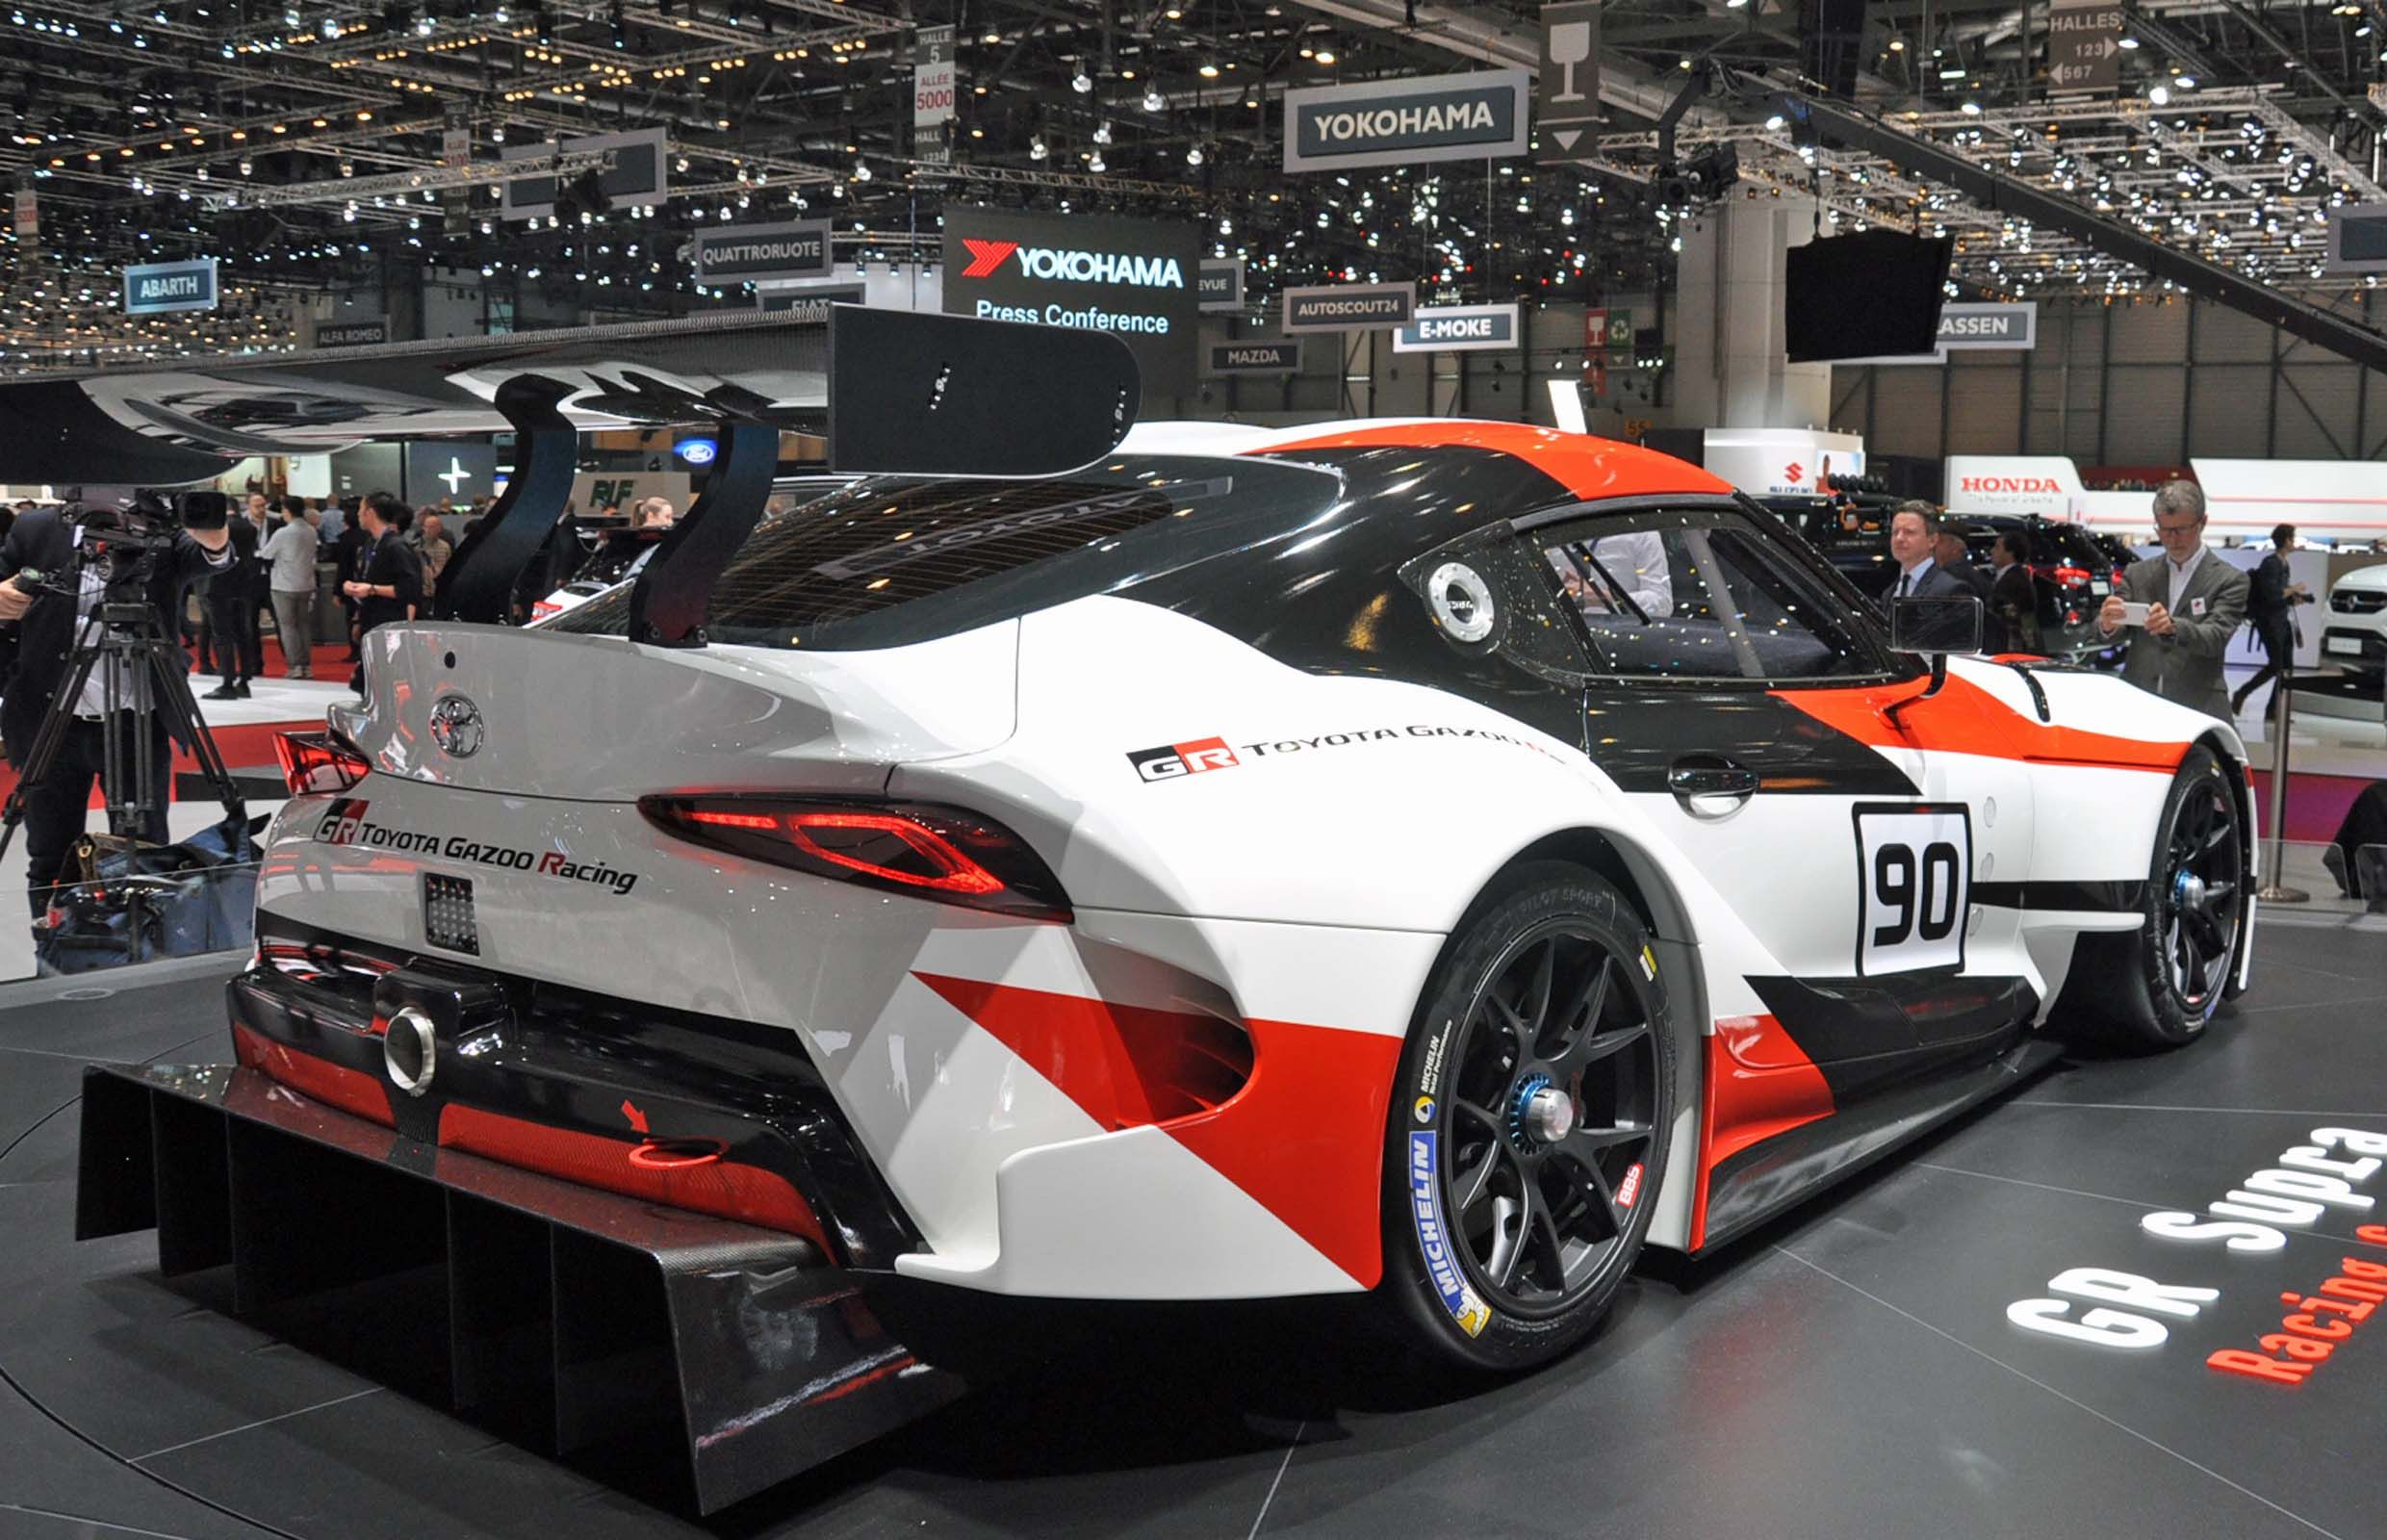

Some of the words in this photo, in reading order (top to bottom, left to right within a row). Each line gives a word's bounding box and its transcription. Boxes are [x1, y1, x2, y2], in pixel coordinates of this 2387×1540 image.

[2050, 12, 2120, 32] HALLES
[919, 31, 951, 45] HALLE
[930, 45, 940, 64] 5
[2076, 42, 2103, 58] 123
[2064, 64, 2092, 80] 567
[916, 89, 953, 110] 5000
[1314, 100, 1495, 142] YOKOHAMA
[703, 241, 822, 266] QUATTRORUOTE
[1015, 246, 1184, 289] YOKOHAMA
[140, 275, 198, 298] ABARTH
[1198, 278, 1227, 292] EVUE
[976, 299, 1039, 324] Press
[1044, 304, 1169, 334] Conference
[1298, 298, 1399, 318] AUTOSCOUT24
[1419, 318, 1492, 339] E-MOKE
[1937, 317, 2009, 335] ASSEN
[1228, 347, 1281, 365] MAZDA
[1961, 476, 2063, 494] HONDA
[1134, 746, 1239, 783] GR
[1242, 729, 1399, 757] TOYOTA
[361, 822, 440, 855] TOYOTA
[444, 836, 534, 870] GAZOO
[537, 851, 638, 895] Racing
[1873, 841, 1960, 948] 90
[1420, 1034, 1441, 1093] MICHELIN
[1618, 1165, 1640, 1205] BBS
[1414, 1138, 1460, 1297] MICHELIN
[2006, 1267, 2220, 1349] GR
[2140, 1126, 2387, 1251] Supra
